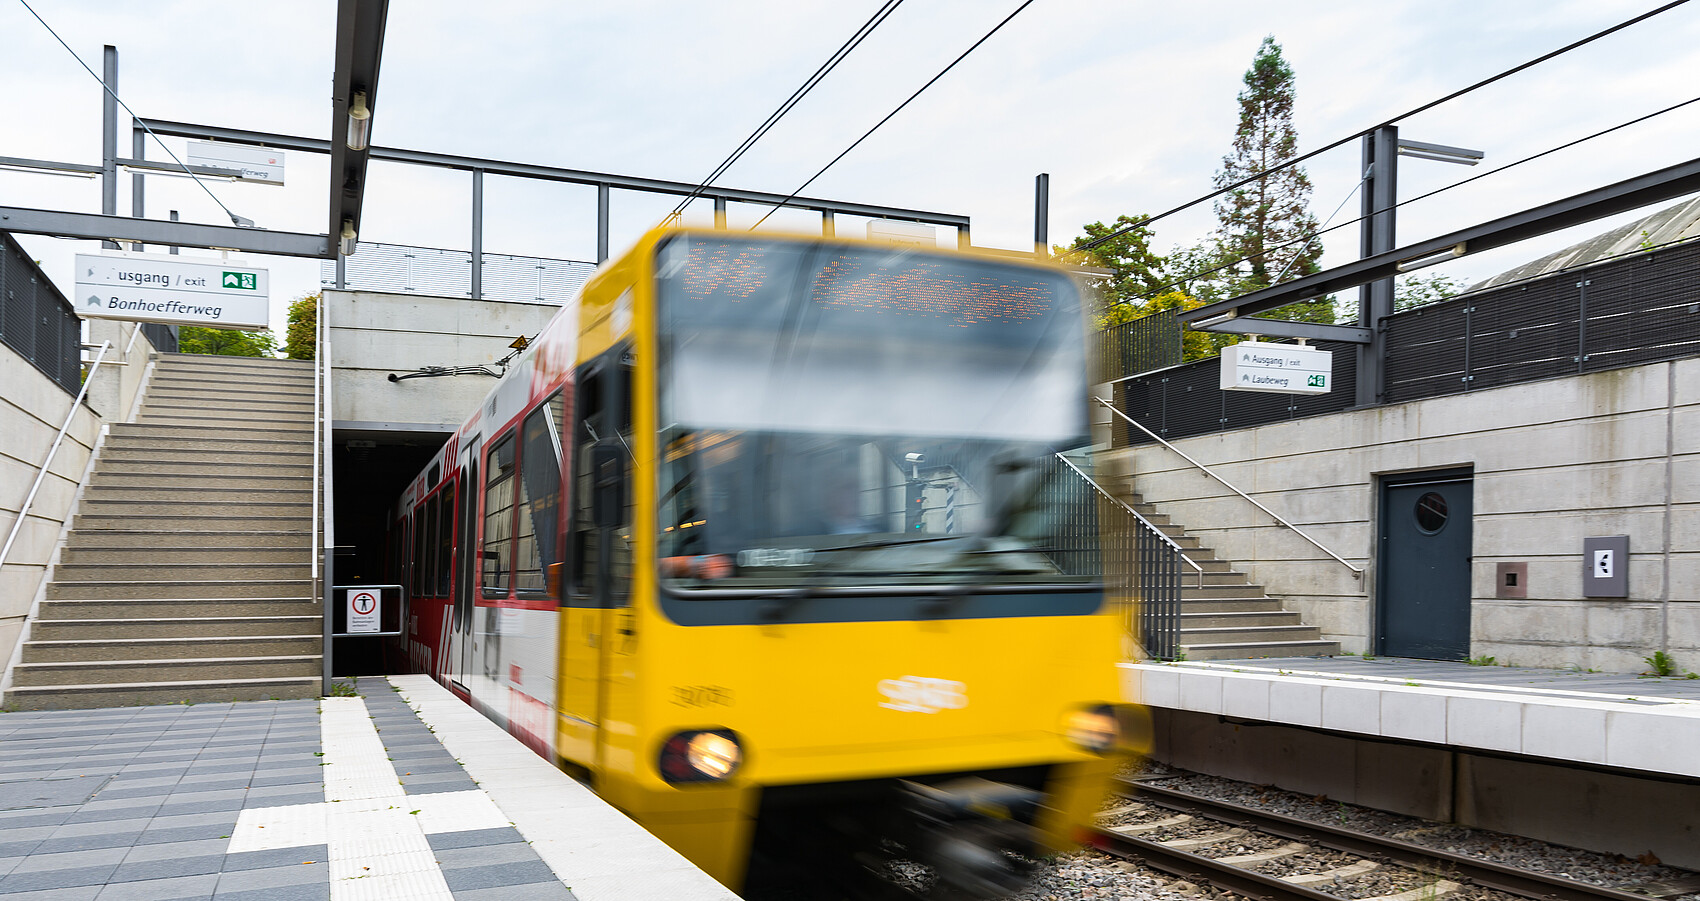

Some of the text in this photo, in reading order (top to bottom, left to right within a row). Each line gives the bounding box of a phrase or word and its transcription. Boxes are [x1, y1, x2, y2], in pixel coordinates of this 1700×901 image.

[106, 267, 170, 287] usgang
[184, 276, 206, 287] exit
[108, 296, 222, 319] Bonhoefferweg
[1252, 354, 1283, 367] Ausgang
[1289, 358, 1301, 367] exit
[1252, 374, 1289, 387] Laubeweg
